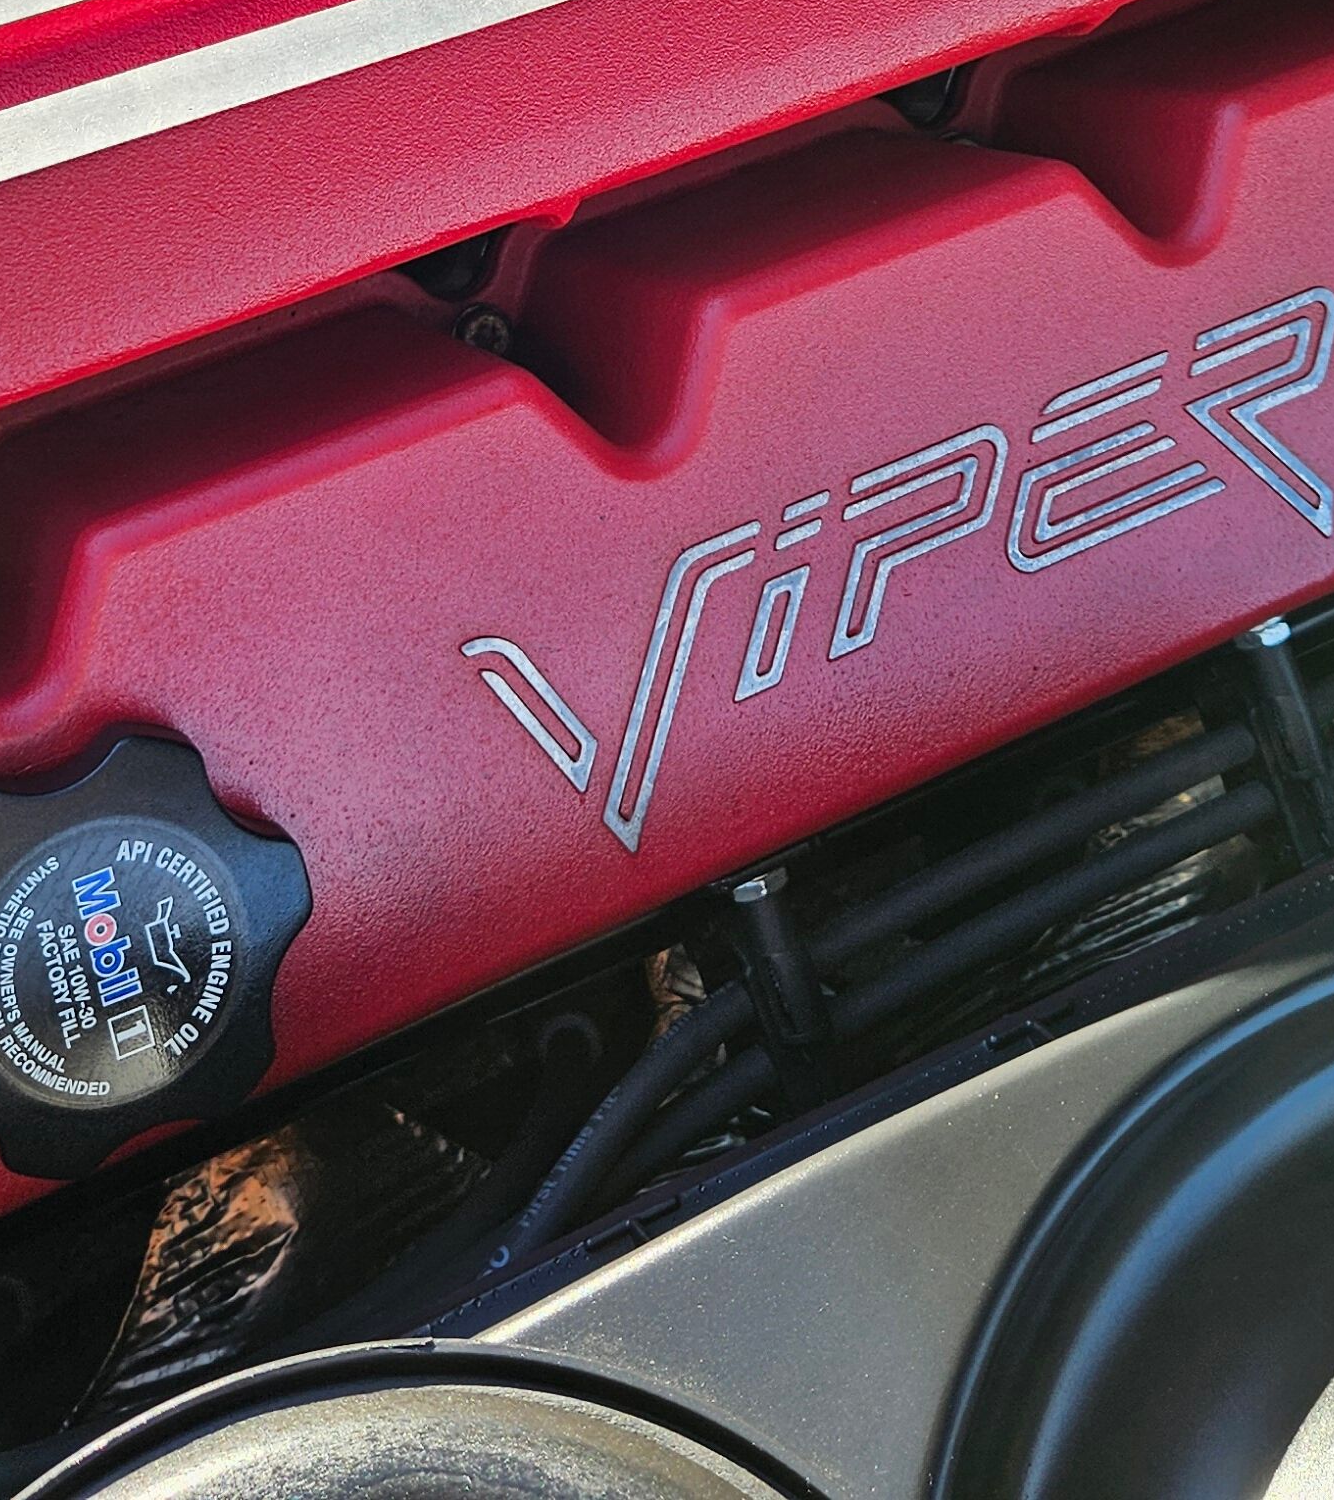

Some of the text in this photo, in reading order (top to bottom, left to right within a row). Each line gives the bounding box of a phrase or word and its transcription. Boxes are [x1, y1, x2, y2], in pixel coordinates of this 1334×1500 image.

[8, 905, 35, 941] SEE
[57, 923, 97, 1030] SAE 10W-30
[72, 866, 144, 1008] Mobil
[116, 839, 232, 1057] API CERTIFIED ENGINE OIL
[36, 918, 82, 1050] FACTORY FILL
[13, 1020, 66, 1074] MANUAL
